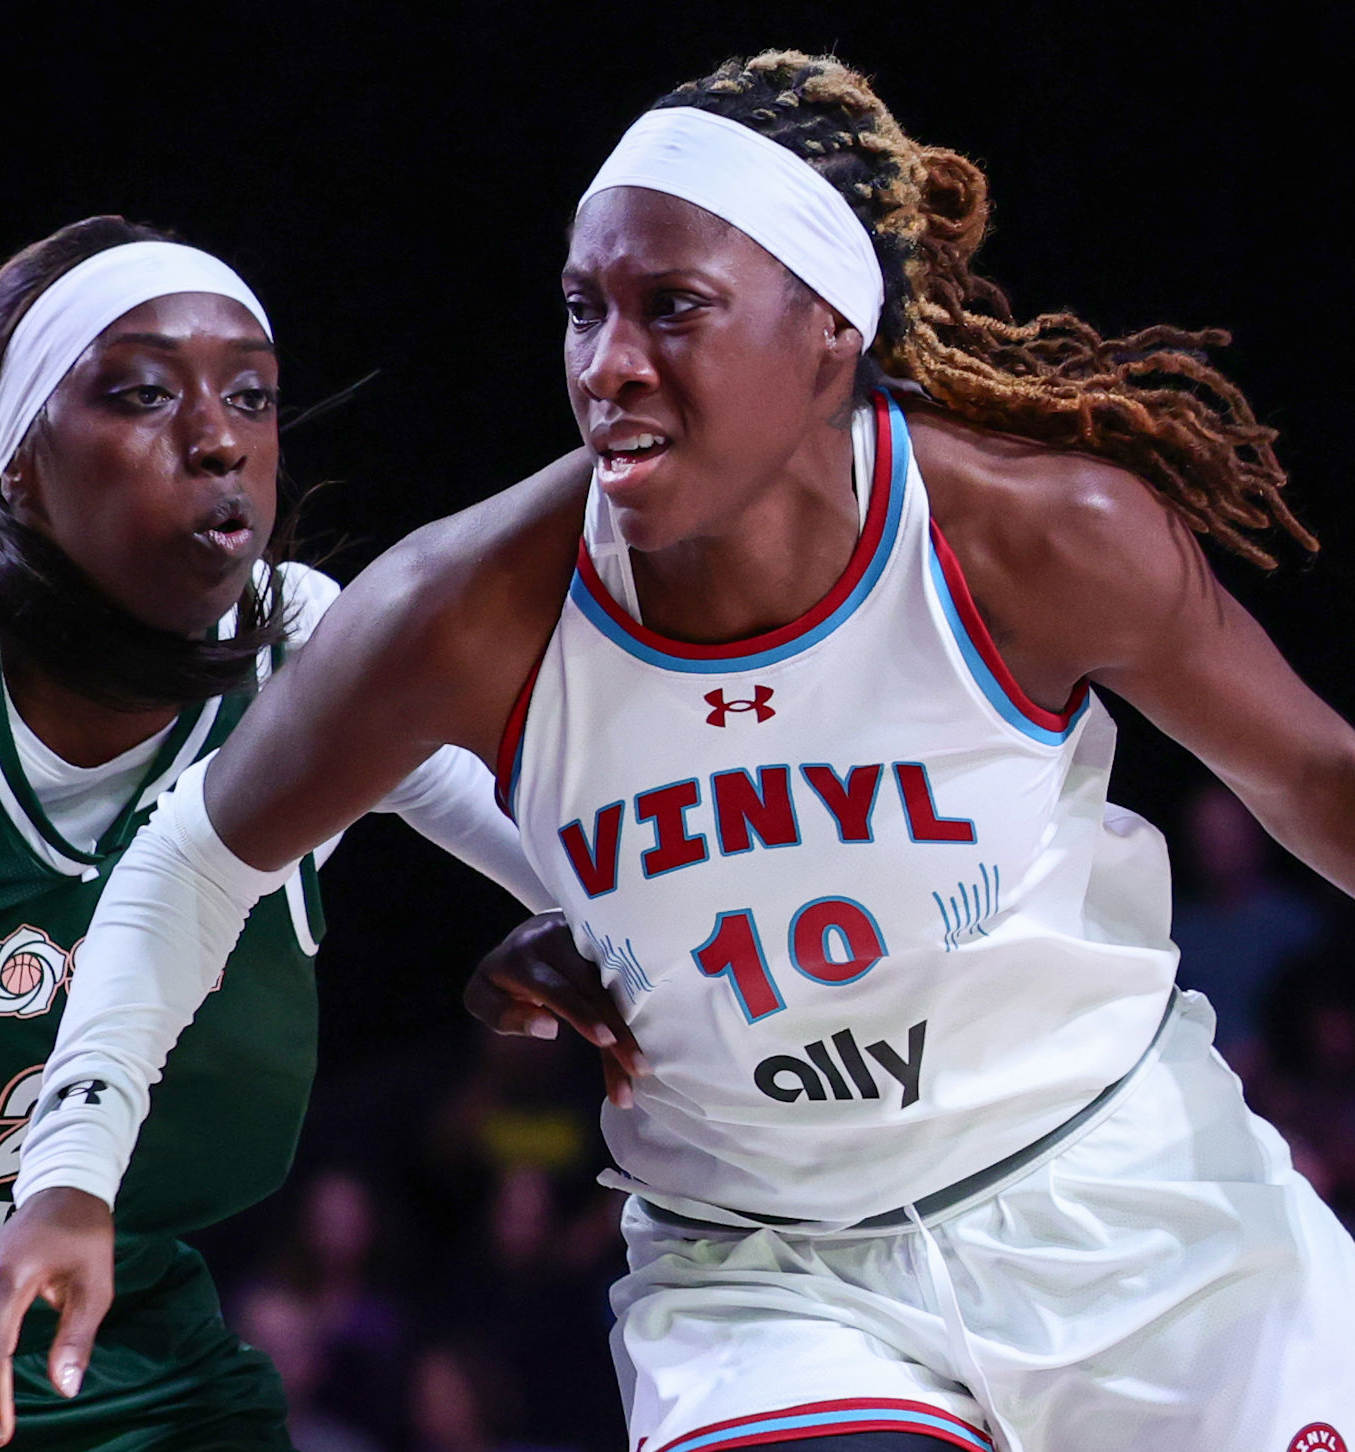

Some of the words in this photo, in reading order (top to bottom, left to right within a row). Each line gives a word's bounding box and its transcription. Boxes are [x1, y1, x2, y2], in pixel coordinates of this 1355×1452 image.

[557, 761, 978, 899] VINYL
[691, 895, 889, 1025] 10
[754, 1020, 927, 1110] ally
